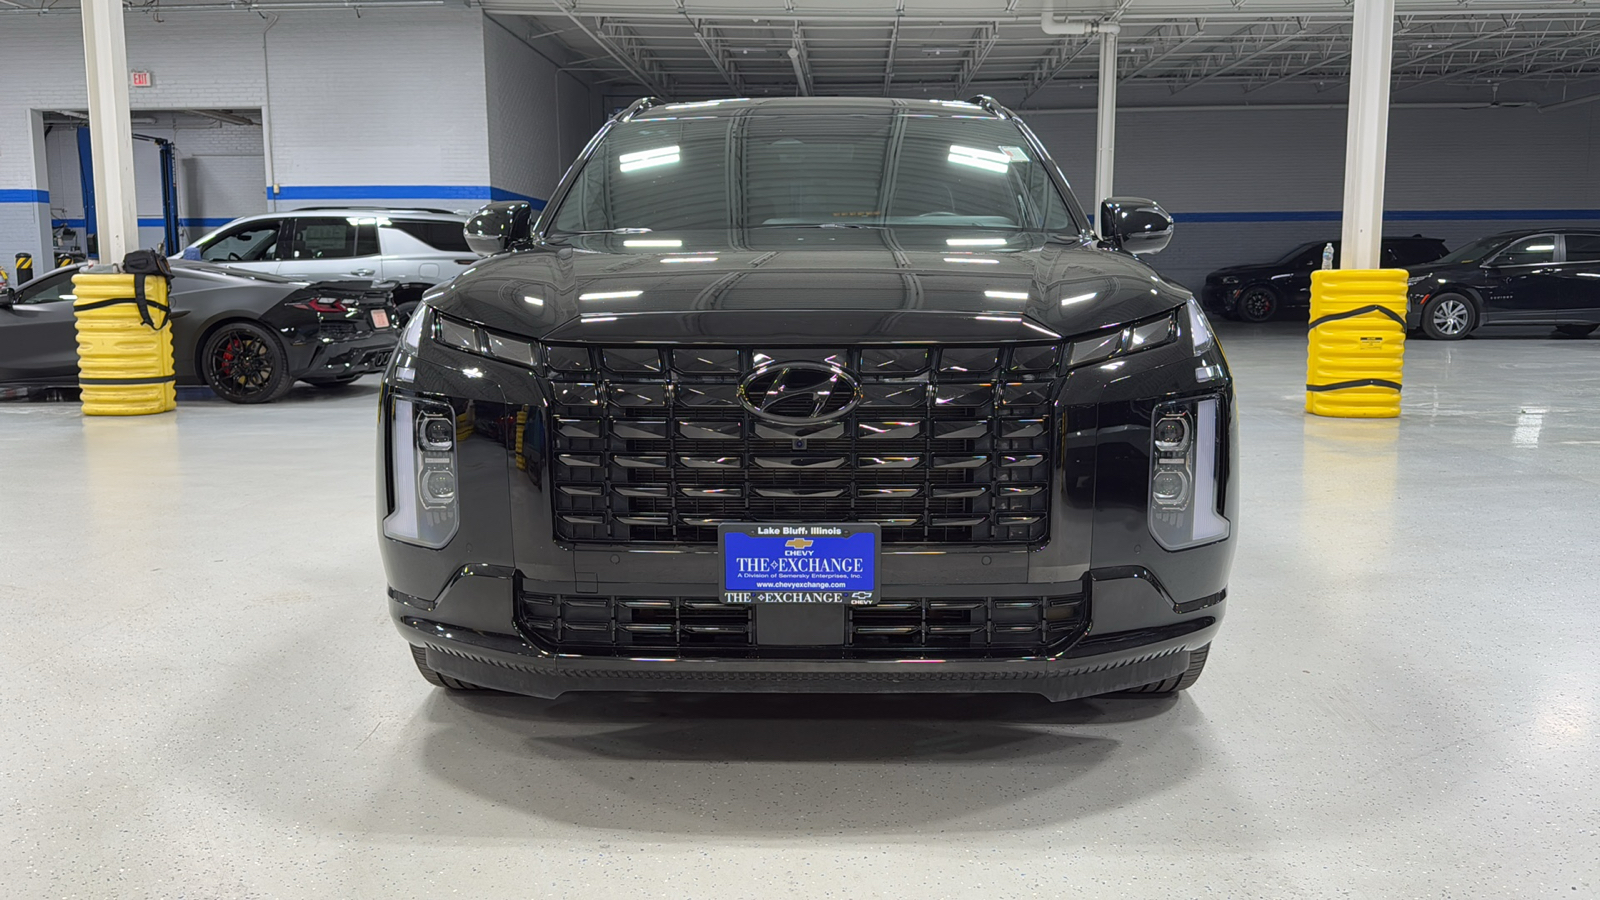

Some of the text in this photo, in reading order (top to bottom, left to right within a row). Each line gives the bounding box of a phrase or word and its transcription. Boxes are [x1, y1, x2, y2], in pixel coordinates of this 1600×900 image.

[133, 73, 147, 85] EXIT
[757, 526, 842, 535] Lake Bluff, Illinois
[736, 557, 864, 573] THE EXCHANGE
[756, 581, 846, 589] www.chevyexchange.com
[724, 592, 843, 603] THE EXCHANGE
